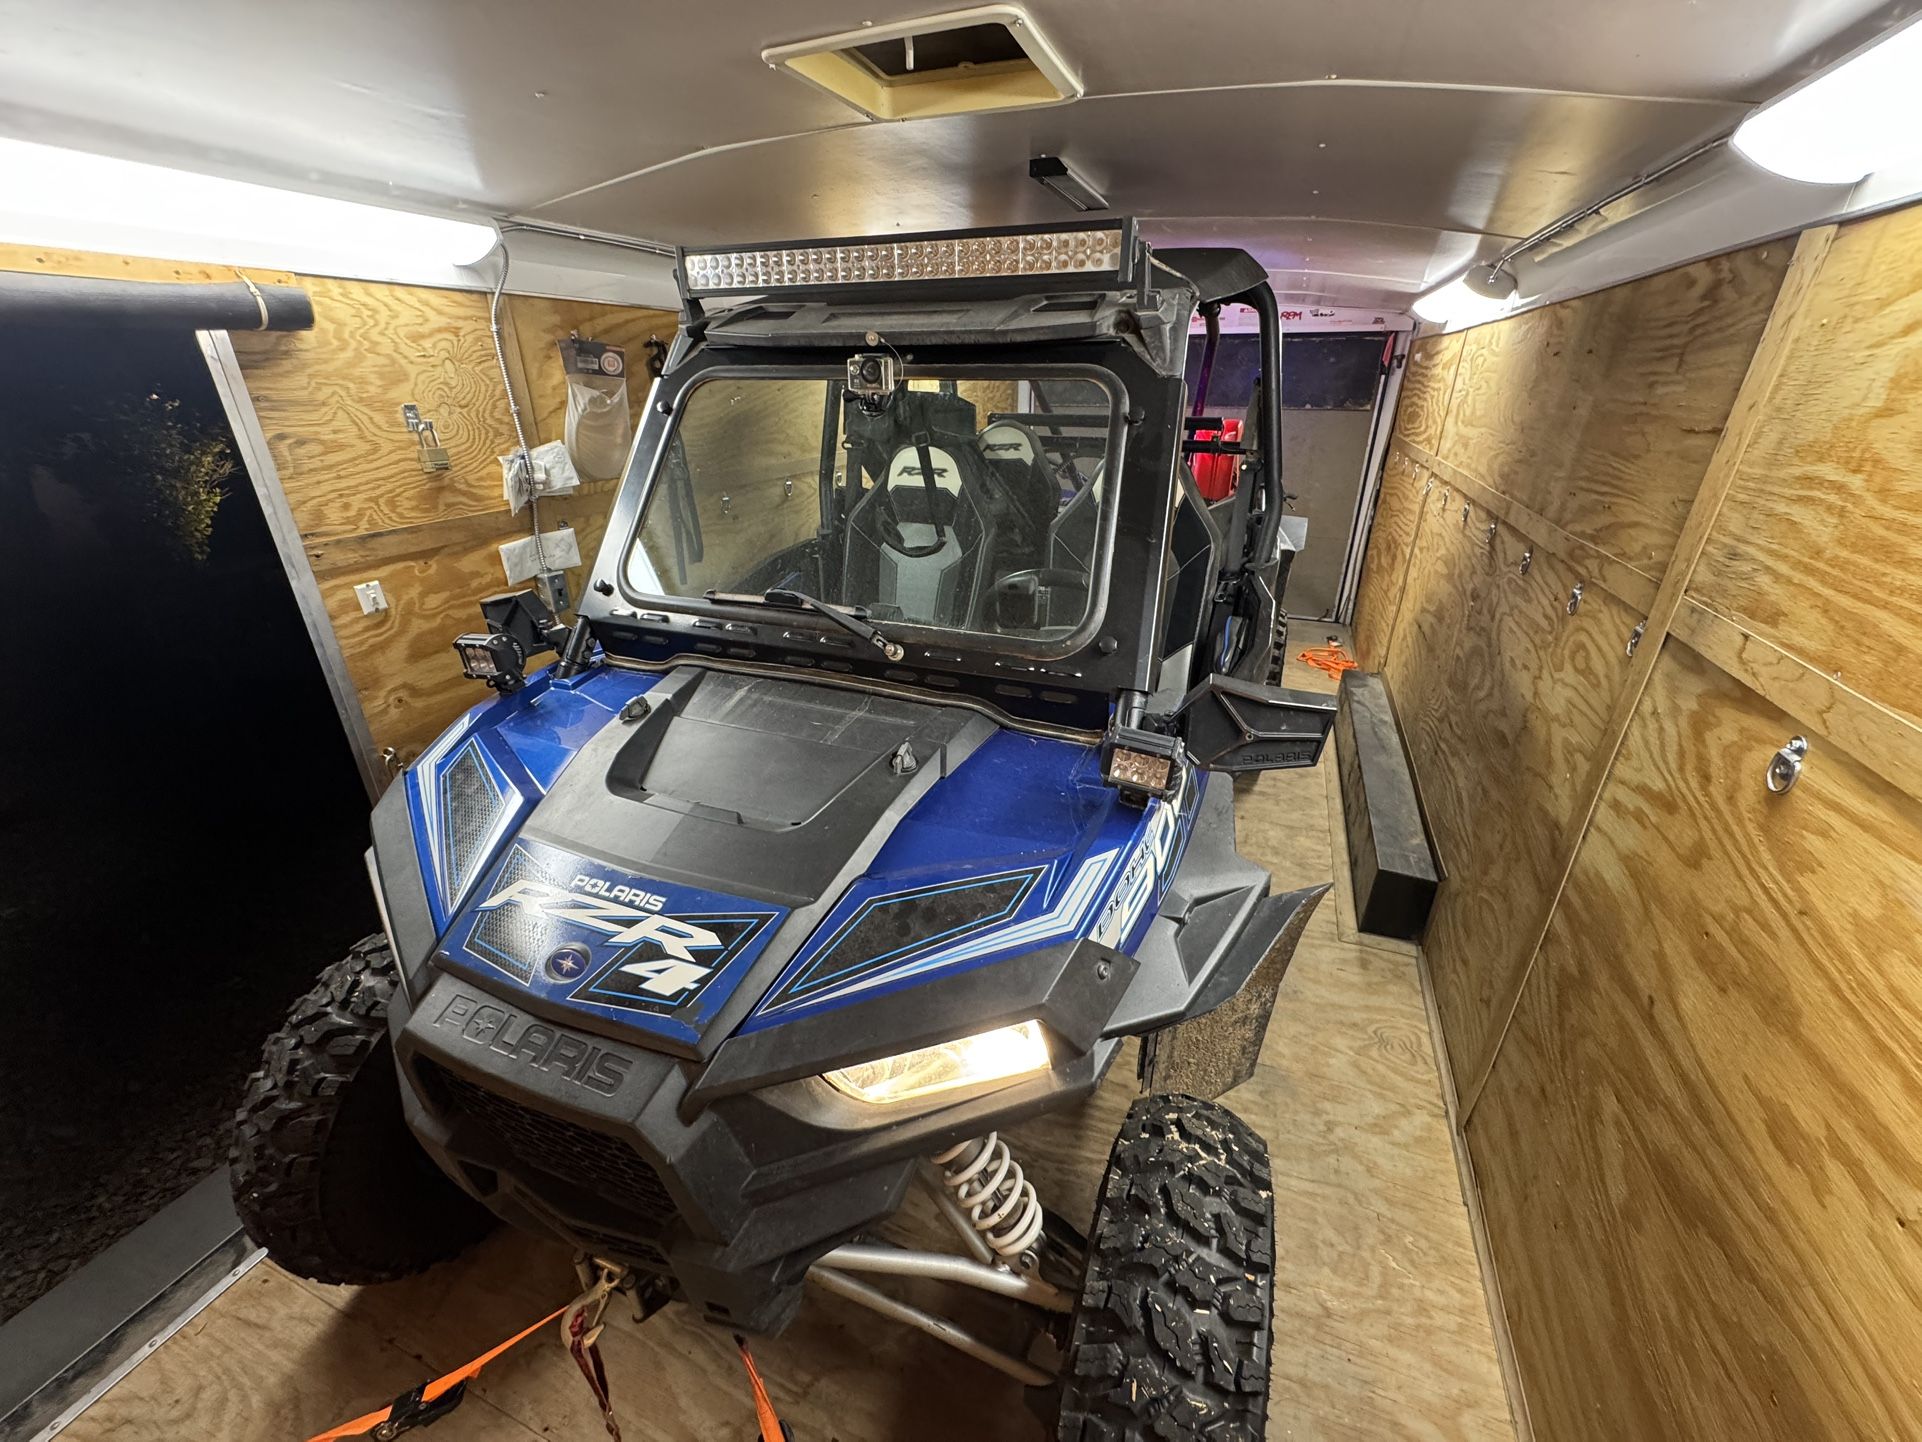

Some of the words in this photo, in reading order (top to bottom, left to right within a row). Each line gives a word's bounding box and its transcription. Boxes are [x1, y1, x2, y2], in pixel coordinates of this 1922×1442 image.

[1241, 751, 1312, 766] POLARIS
[571, 874, 667, 912] POLARIS
[475, 879, 729, 962] RZR
[618, 958, 713, 997] 4
[433, 994, 635, 1098] POLARIS
